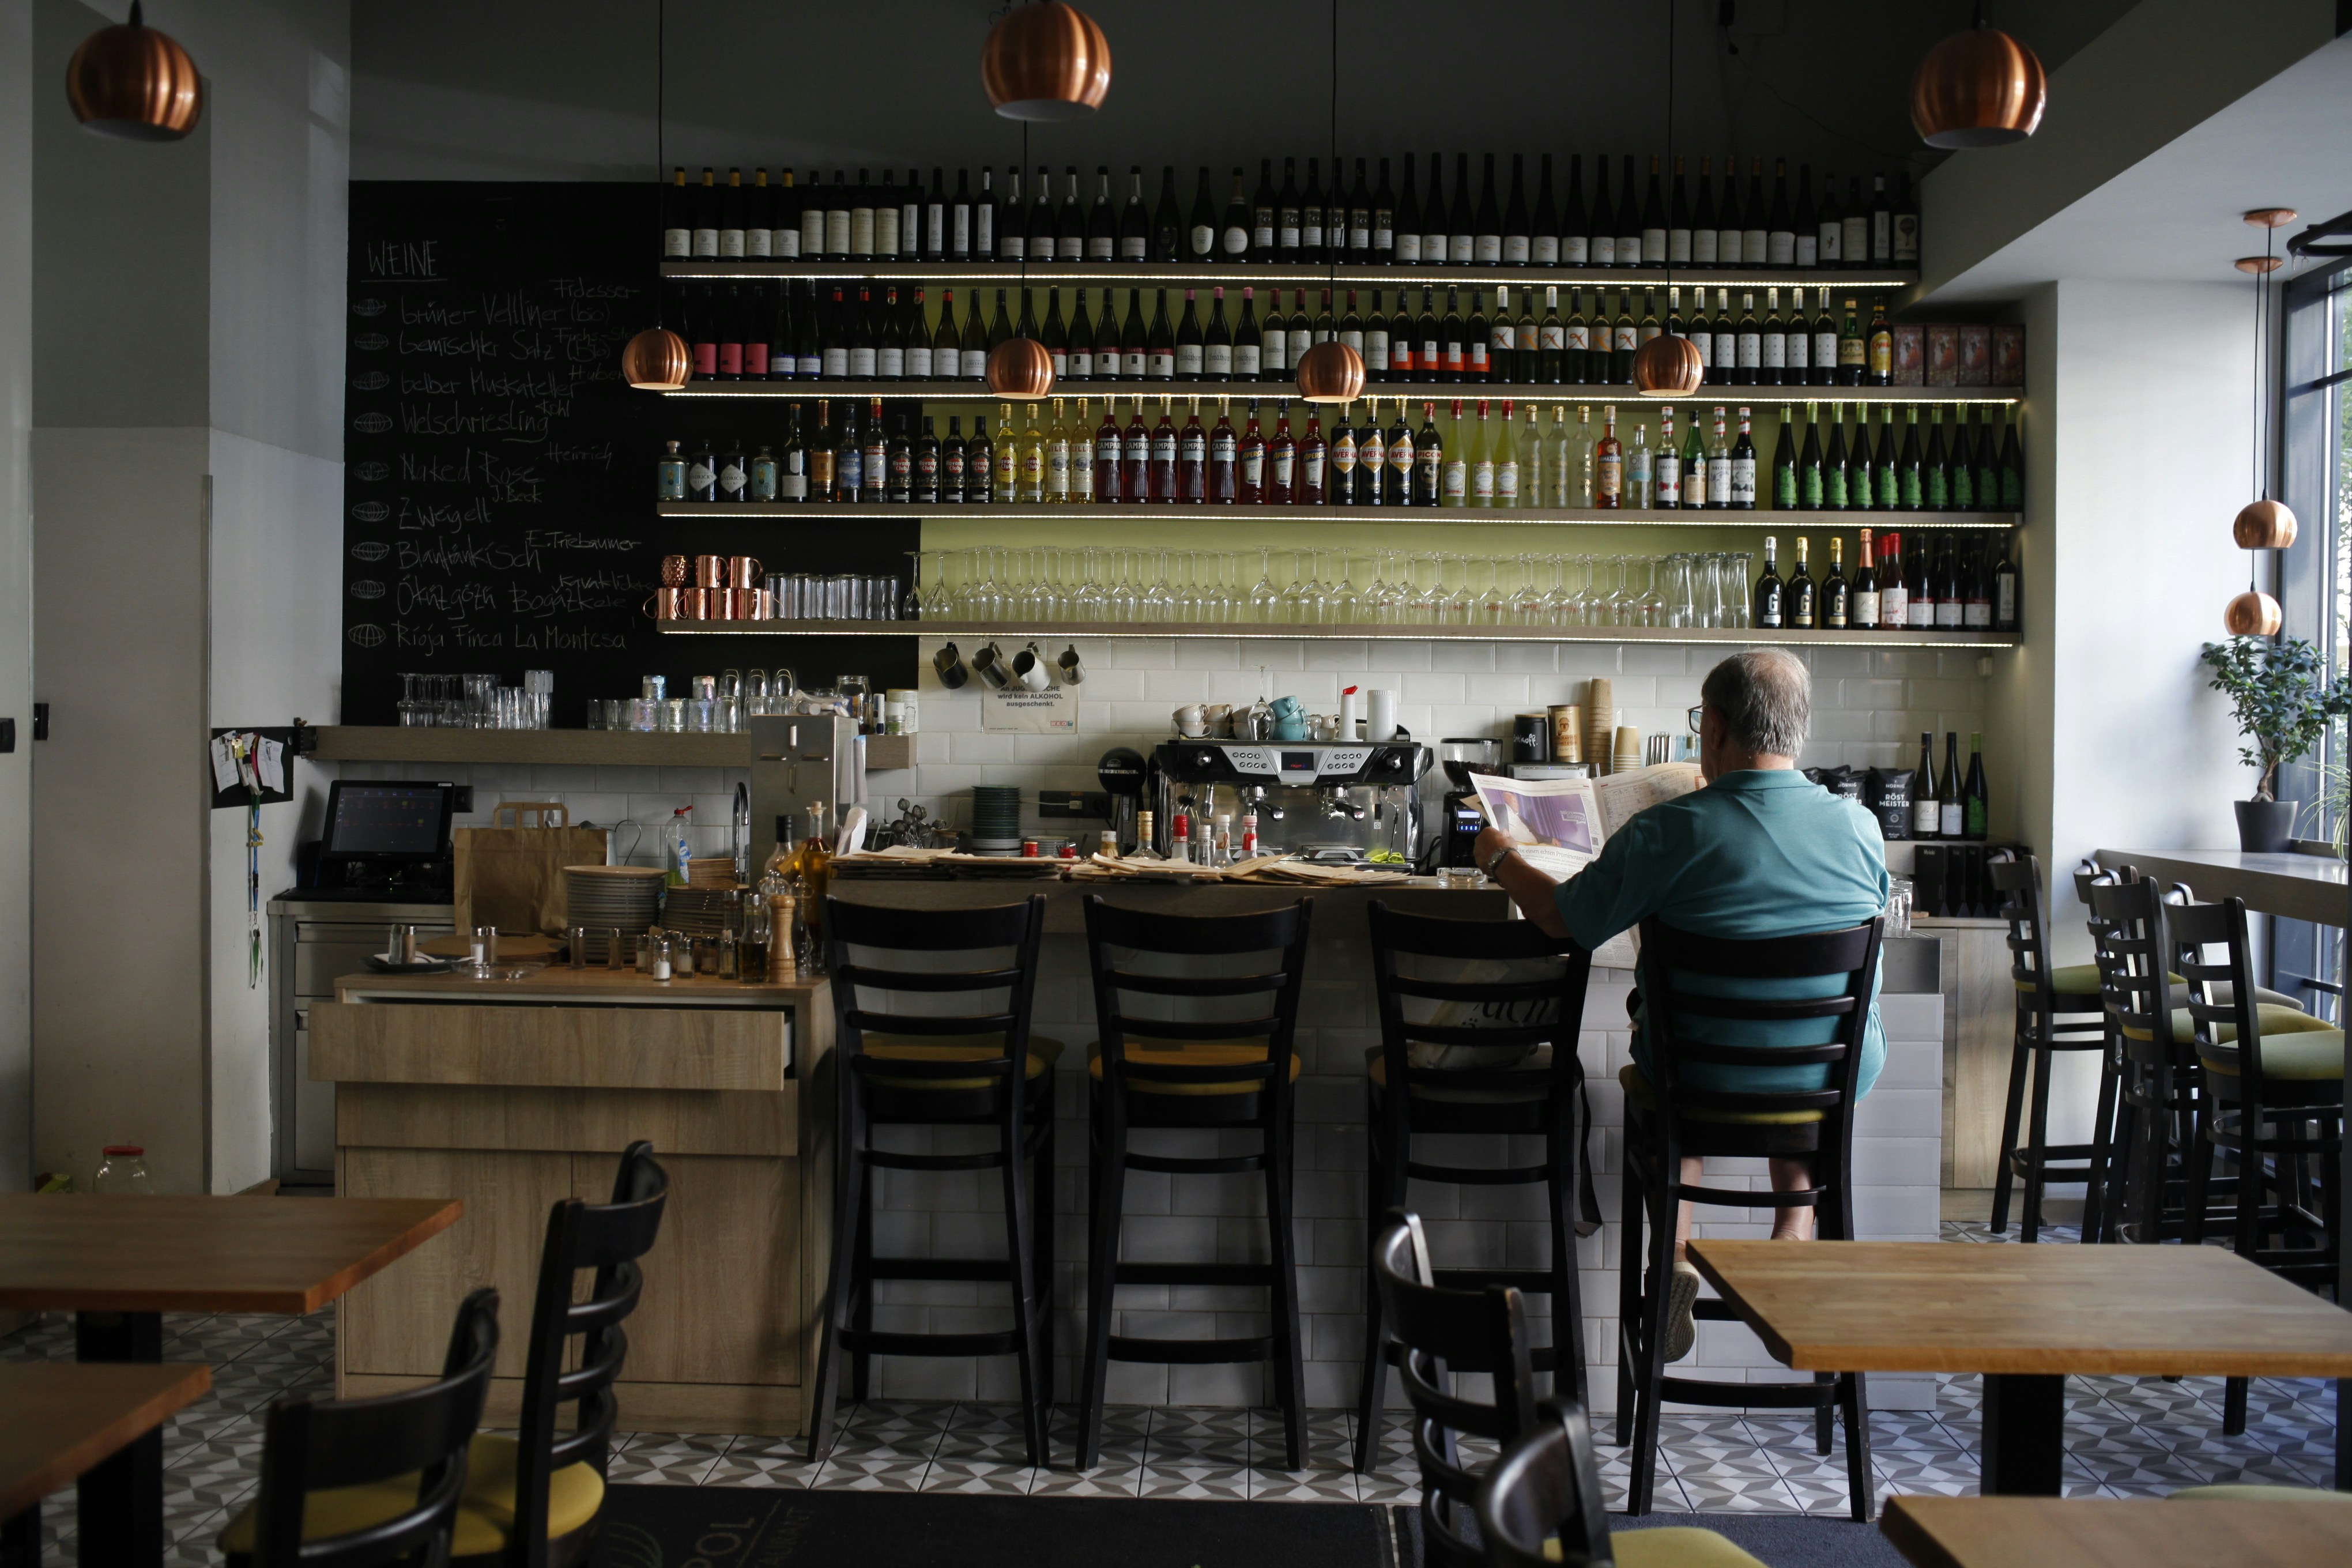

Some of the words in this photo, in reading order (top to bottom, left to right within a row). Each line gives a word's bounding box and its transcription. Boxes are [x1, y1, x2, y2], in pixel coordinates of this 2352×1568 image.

[368, 240, 437, 276] WEINE
[1153, 442, 1177, 450] CAMPARI
[1242, 450, 1264, 460] APEROL
[1273, 450, 1295, 460] APEROL
[1303, 451, 1325, 461] APEROL
[399, 447, 471, 484] Naked
[399, 497, 493, 534] Zweigelt
[1769, 594, 1778, 612] G
[1800, 594, 1810, 612] G
[1834, 594, 1844, 613] G
[391, 620, 444, 657] Rioja
[451, 624, 503, 648] Finca
[515, 624, 538, 650] La
[545, 624, 628, 651] Montesa
